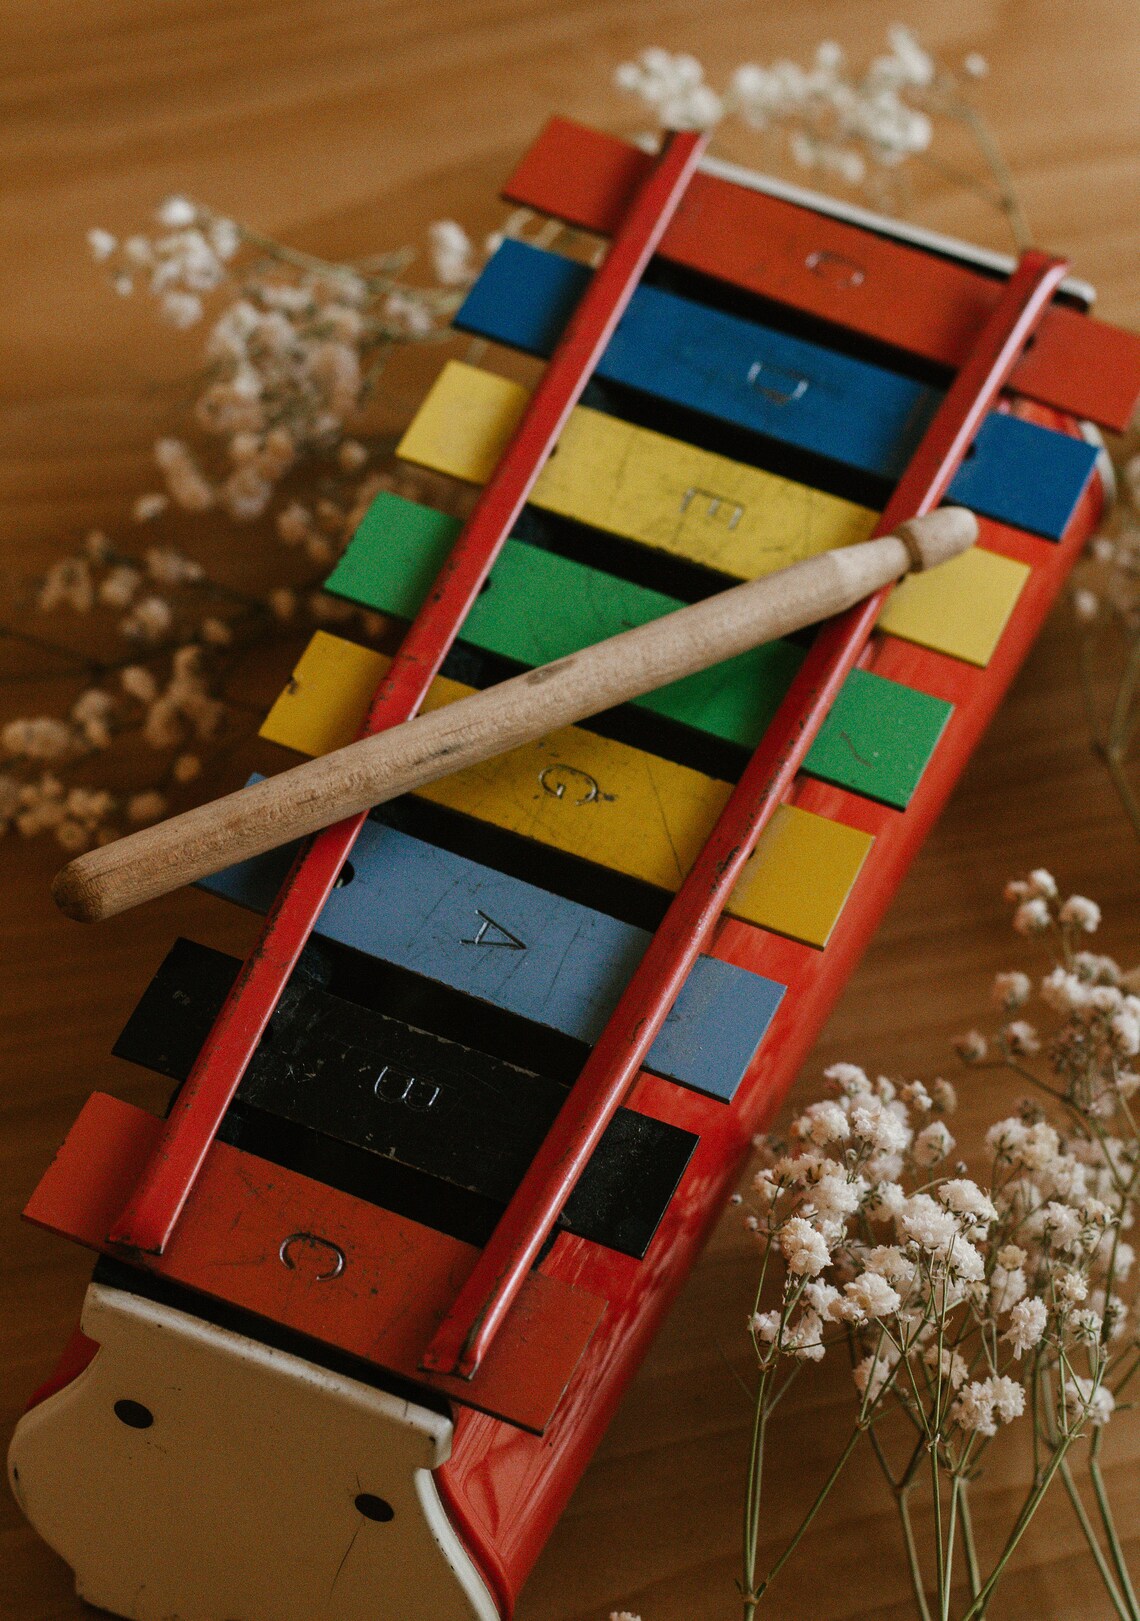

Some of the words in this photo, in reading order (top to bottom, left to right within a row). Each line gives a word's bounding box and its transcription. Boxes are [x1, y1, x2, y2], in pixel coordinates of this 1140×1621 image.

[804, 250, 866, 288] C
[747, 360, 810, 404] D
[679, 486, 745, 530] E
[538, 763, 599, 806] G
[459, 909, 527, 950] A
[374, 1066, 442, 1111] B
[279, 1231, 346, 1281] C
